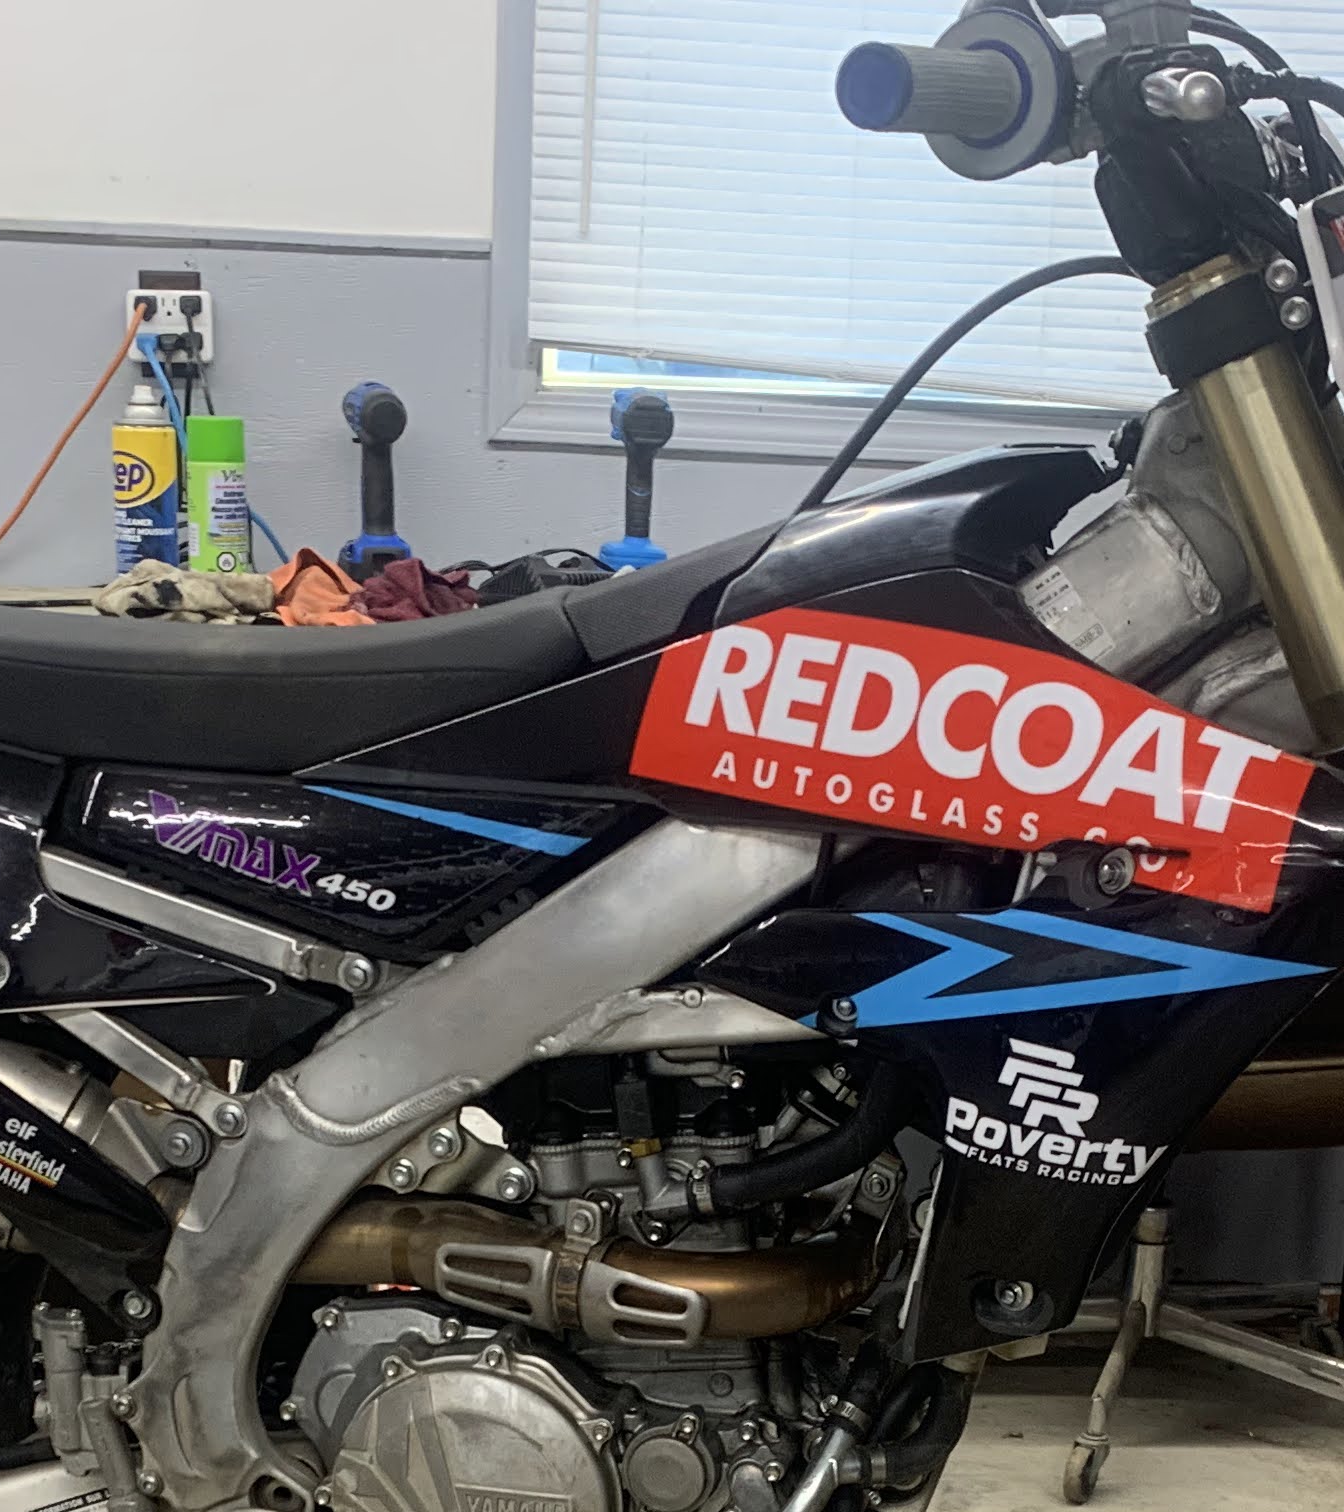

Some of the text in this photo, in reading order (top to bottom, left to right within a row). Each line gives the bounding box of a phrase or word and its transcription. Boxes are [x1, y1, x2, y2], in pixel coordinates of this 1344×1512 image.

[113, 463, 144, 491] ep
[683, 625, 1281, 835] REDCOAT
[712, 750, 1040, 843] AUTOGLASS
[316, 873, 397, 912] 450
[4, 1118, 39, 1140] elf
[944, 1096, 1169, 1184] Poverty
[966, 1146, 1123, 1186] FLATS RACING
